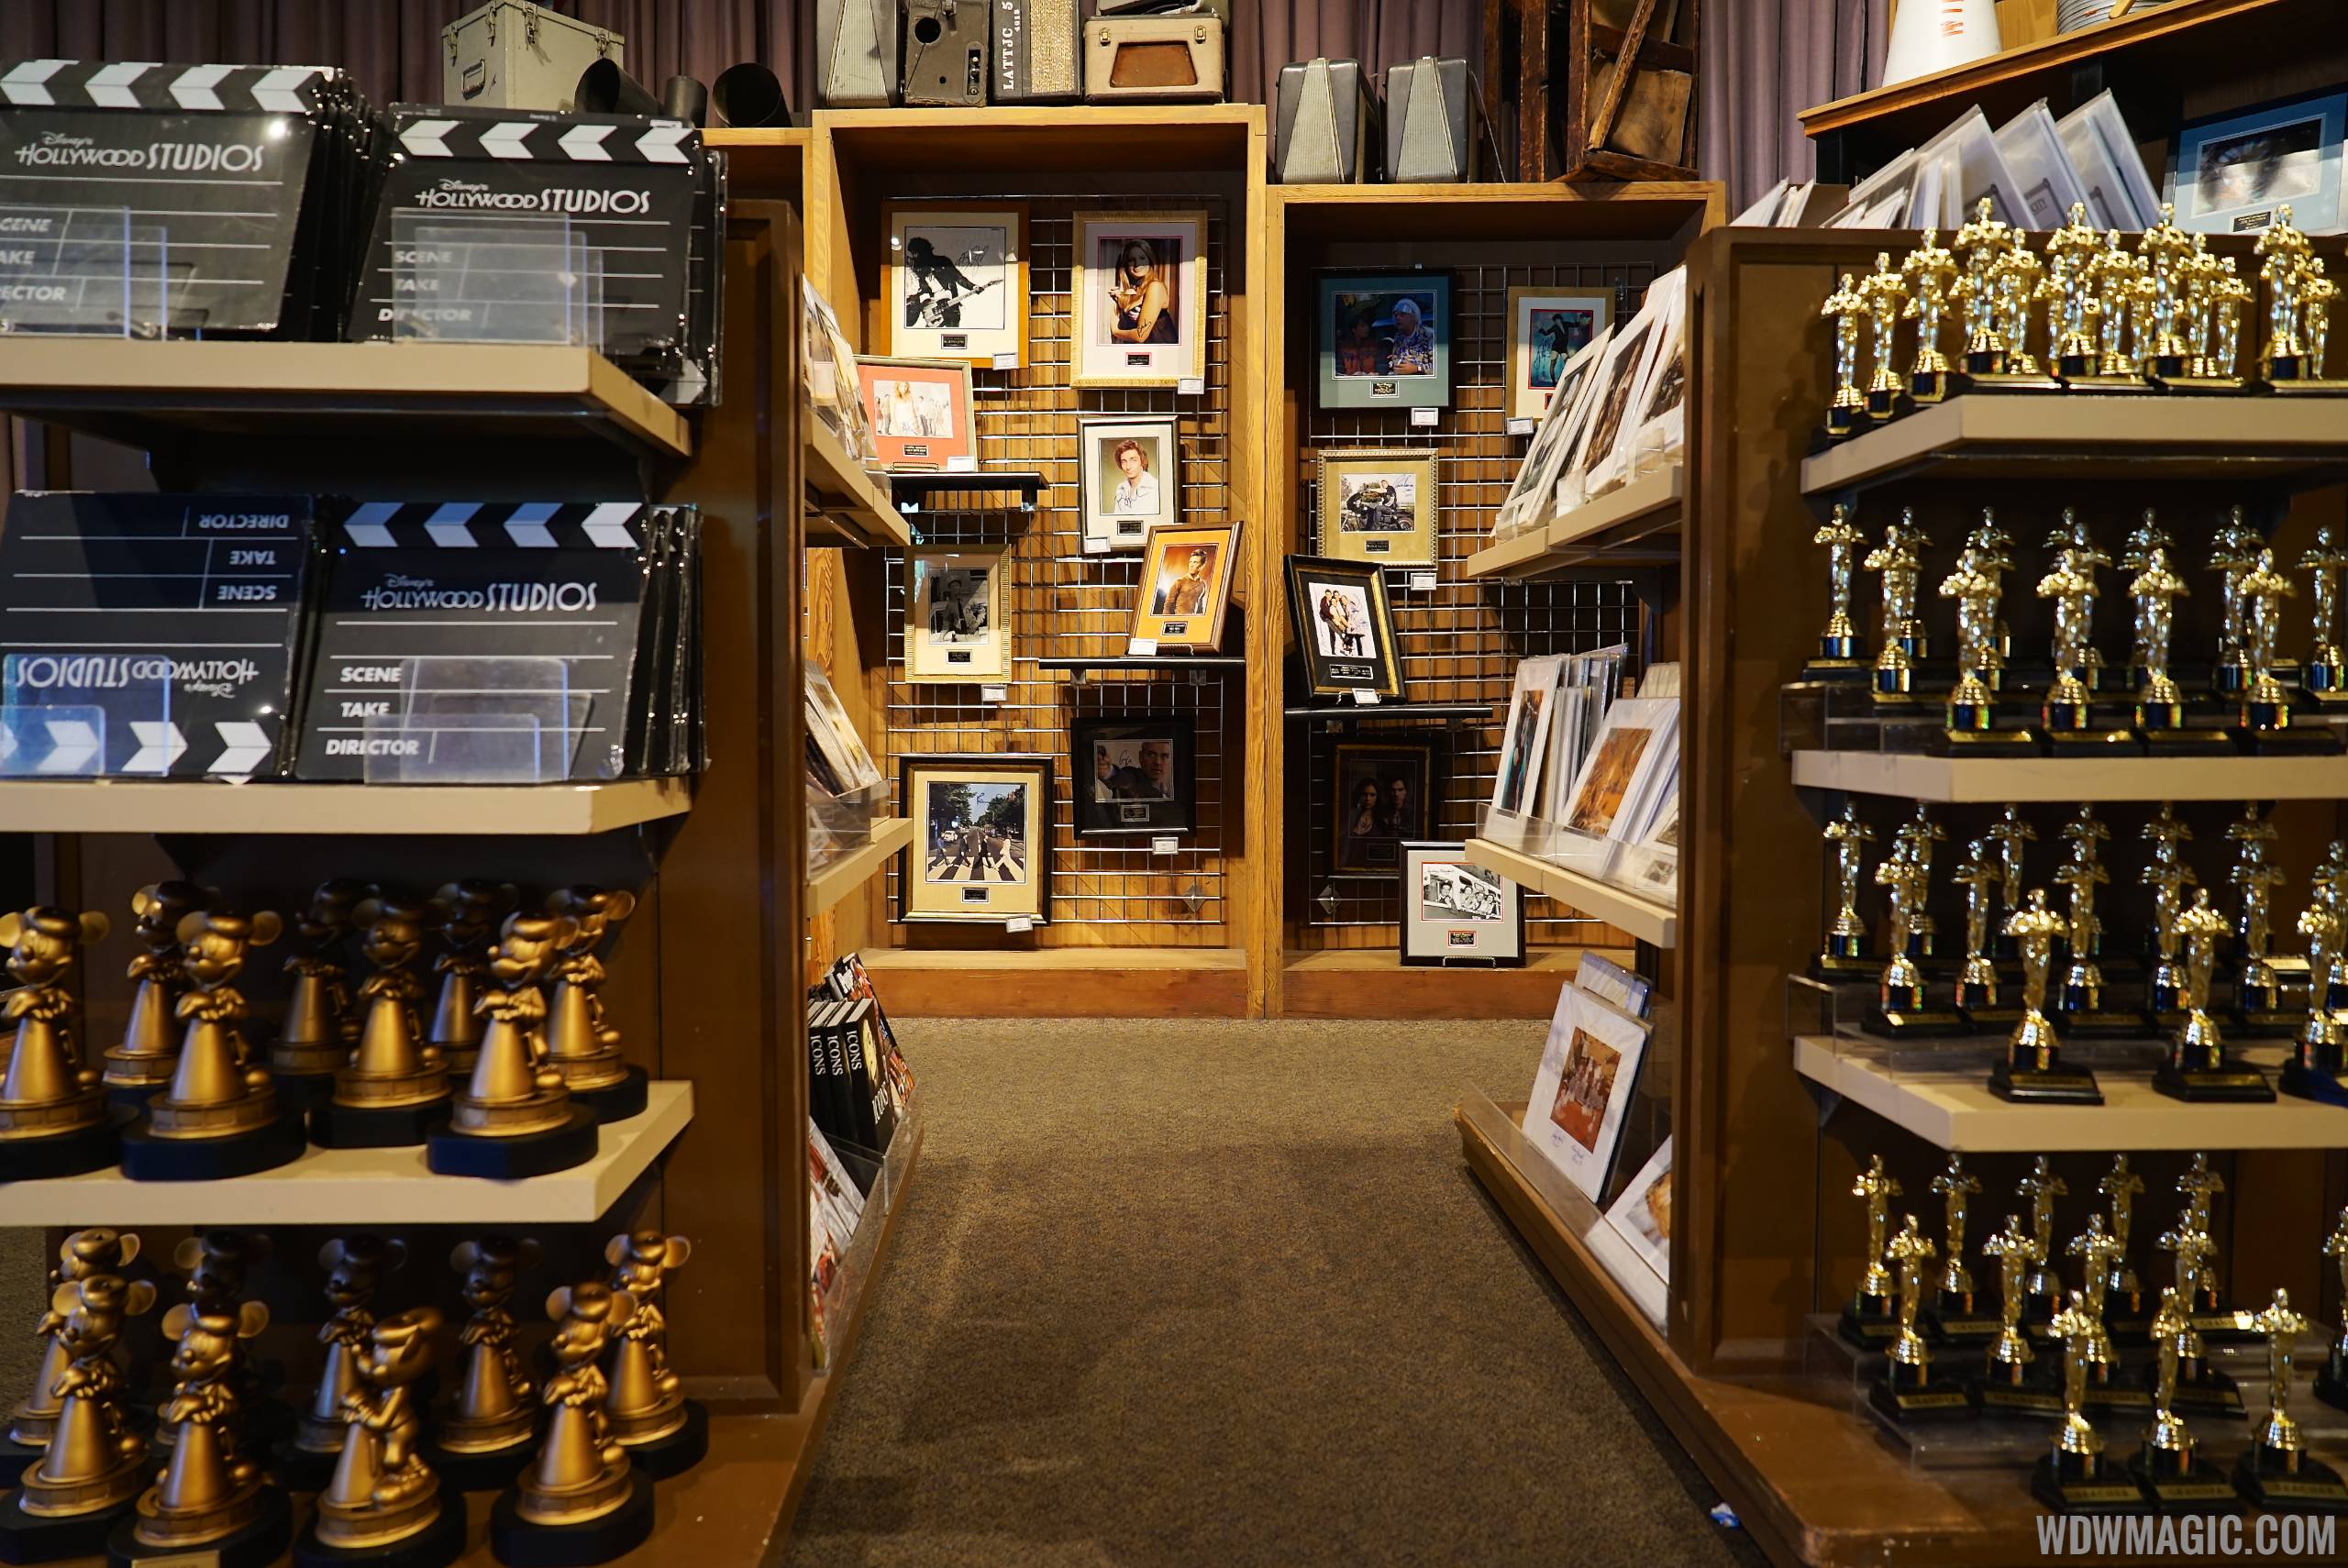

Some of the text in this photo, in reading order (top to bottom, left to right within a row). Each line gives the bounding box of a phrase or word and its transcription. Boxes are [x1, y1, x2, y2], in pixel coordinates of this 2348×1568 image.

[1002, 28, 1014, 90] LATTJC
[41, 131, 94, 149] Disney's
[15, 142, 265, 172] HOLLYWOOD STUDIOS
[438, 178, 490, 193] Disney's
[415, 187, 651, 214] HOLLYWOOD STUDIOS
[394, 249, 453, 264] SCENE
[394, 277, 440, 292] TAKE
[197, 513, 290, 529] DIRECTOR
[229, 549, 277, 566] TAKE
[383, 573, 435, 590] Disney's
[216, 584, 278, 601] SCENE
[360, 581, 598, 612] HOLLYWOOD STUDIOS
[16, 656, 260, 689] HOLLYWOOD STUDIOS
[339, 667, 404, 683] SCENE
[183, 681, 237, 699] Disney's
[339, 701, 391, 718] TAKE
[810, 1034, 826, 1077] ICONS
[827, 1034, 844, 1077] ICONS
[847, 1030, 862, 1071] ICONS
